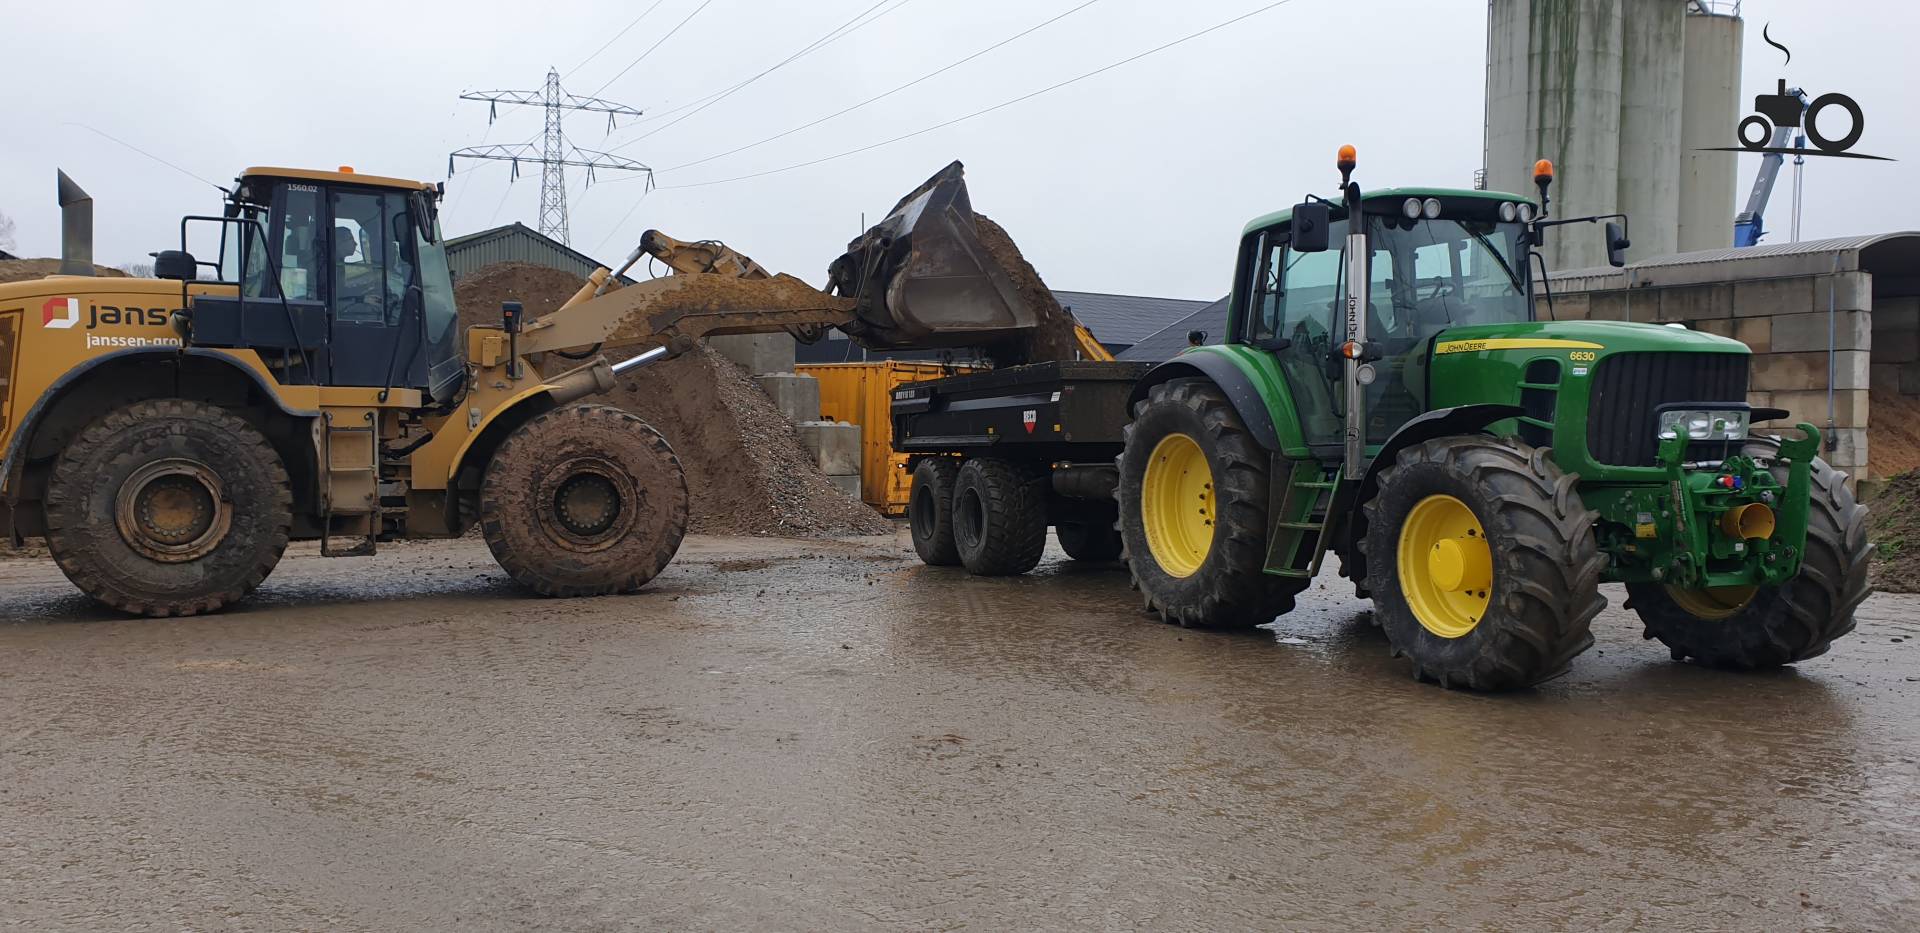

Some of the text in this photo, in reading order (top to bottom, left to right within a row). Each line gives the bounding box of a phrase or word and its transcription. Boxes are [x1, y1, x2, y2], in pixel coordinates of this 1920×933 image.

[86, 299, 173, 329] jans
[1349, 294, 1357, 322] JOHN
[1447, 342, 1487, 352] JOHN DEERE
[1570, 351, 1595, 361] 6630
